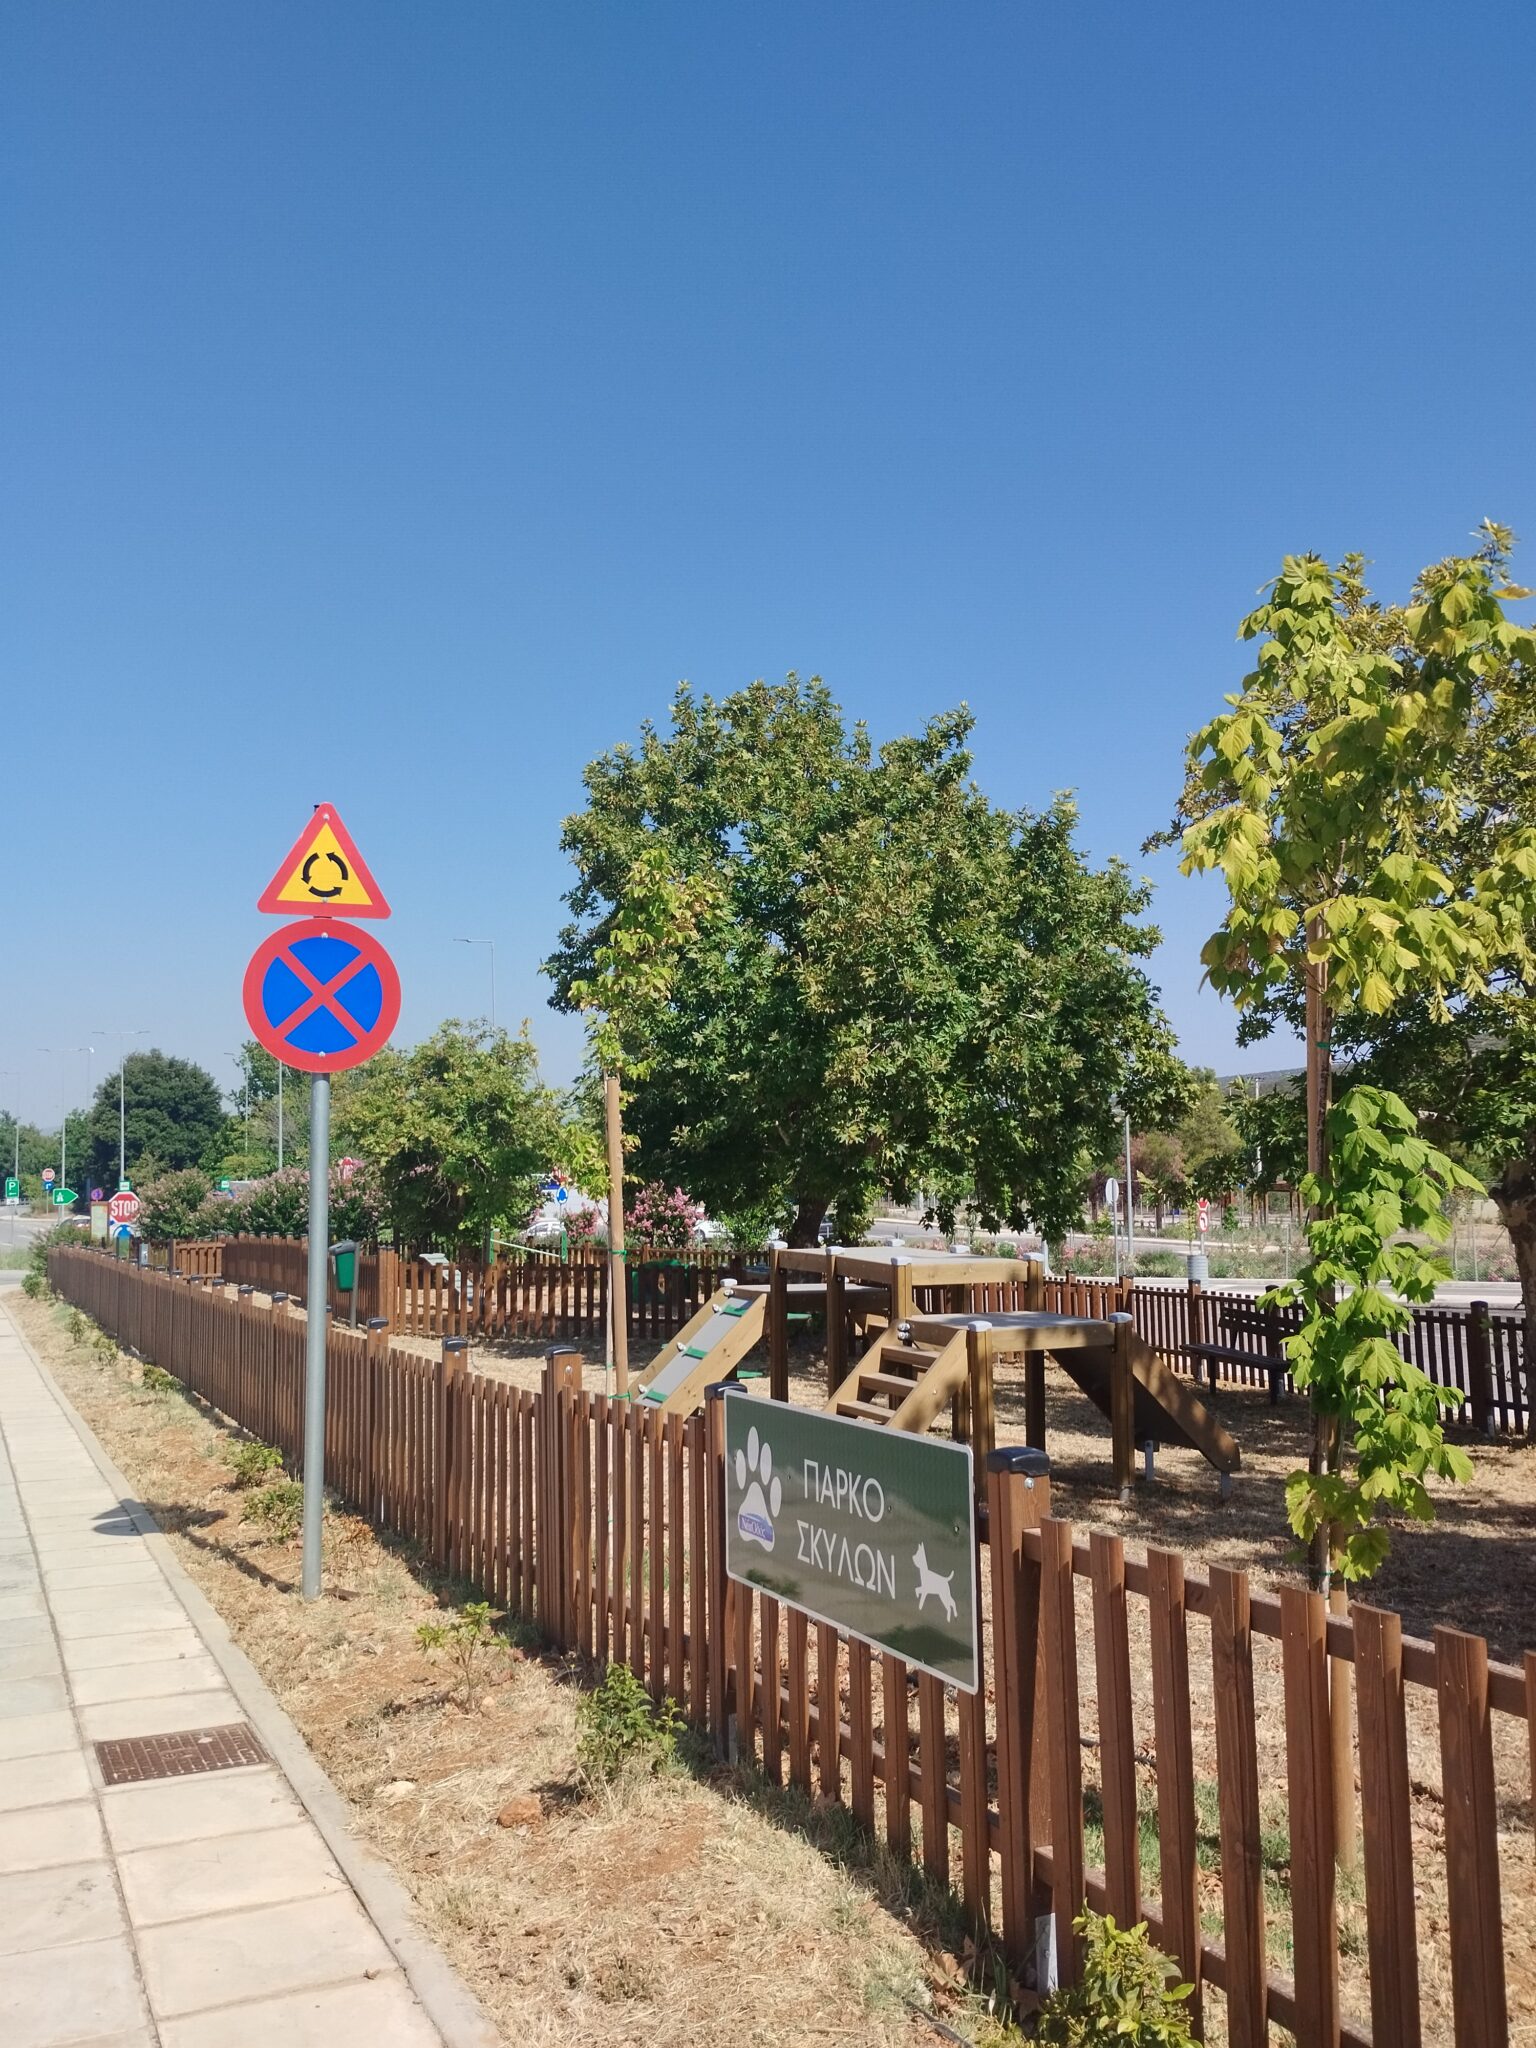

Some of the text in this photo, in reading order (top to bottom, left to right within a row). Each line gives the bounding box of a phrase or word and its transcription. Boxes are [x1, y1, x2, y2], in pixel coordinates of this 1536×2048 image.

[110, 1200, 139, 1217] STOP
[804, 1458, 885, 1523] ΠΑΡΚΟ
[796, 1519, 896, 1600] ΣΚΥΛΩΝ
